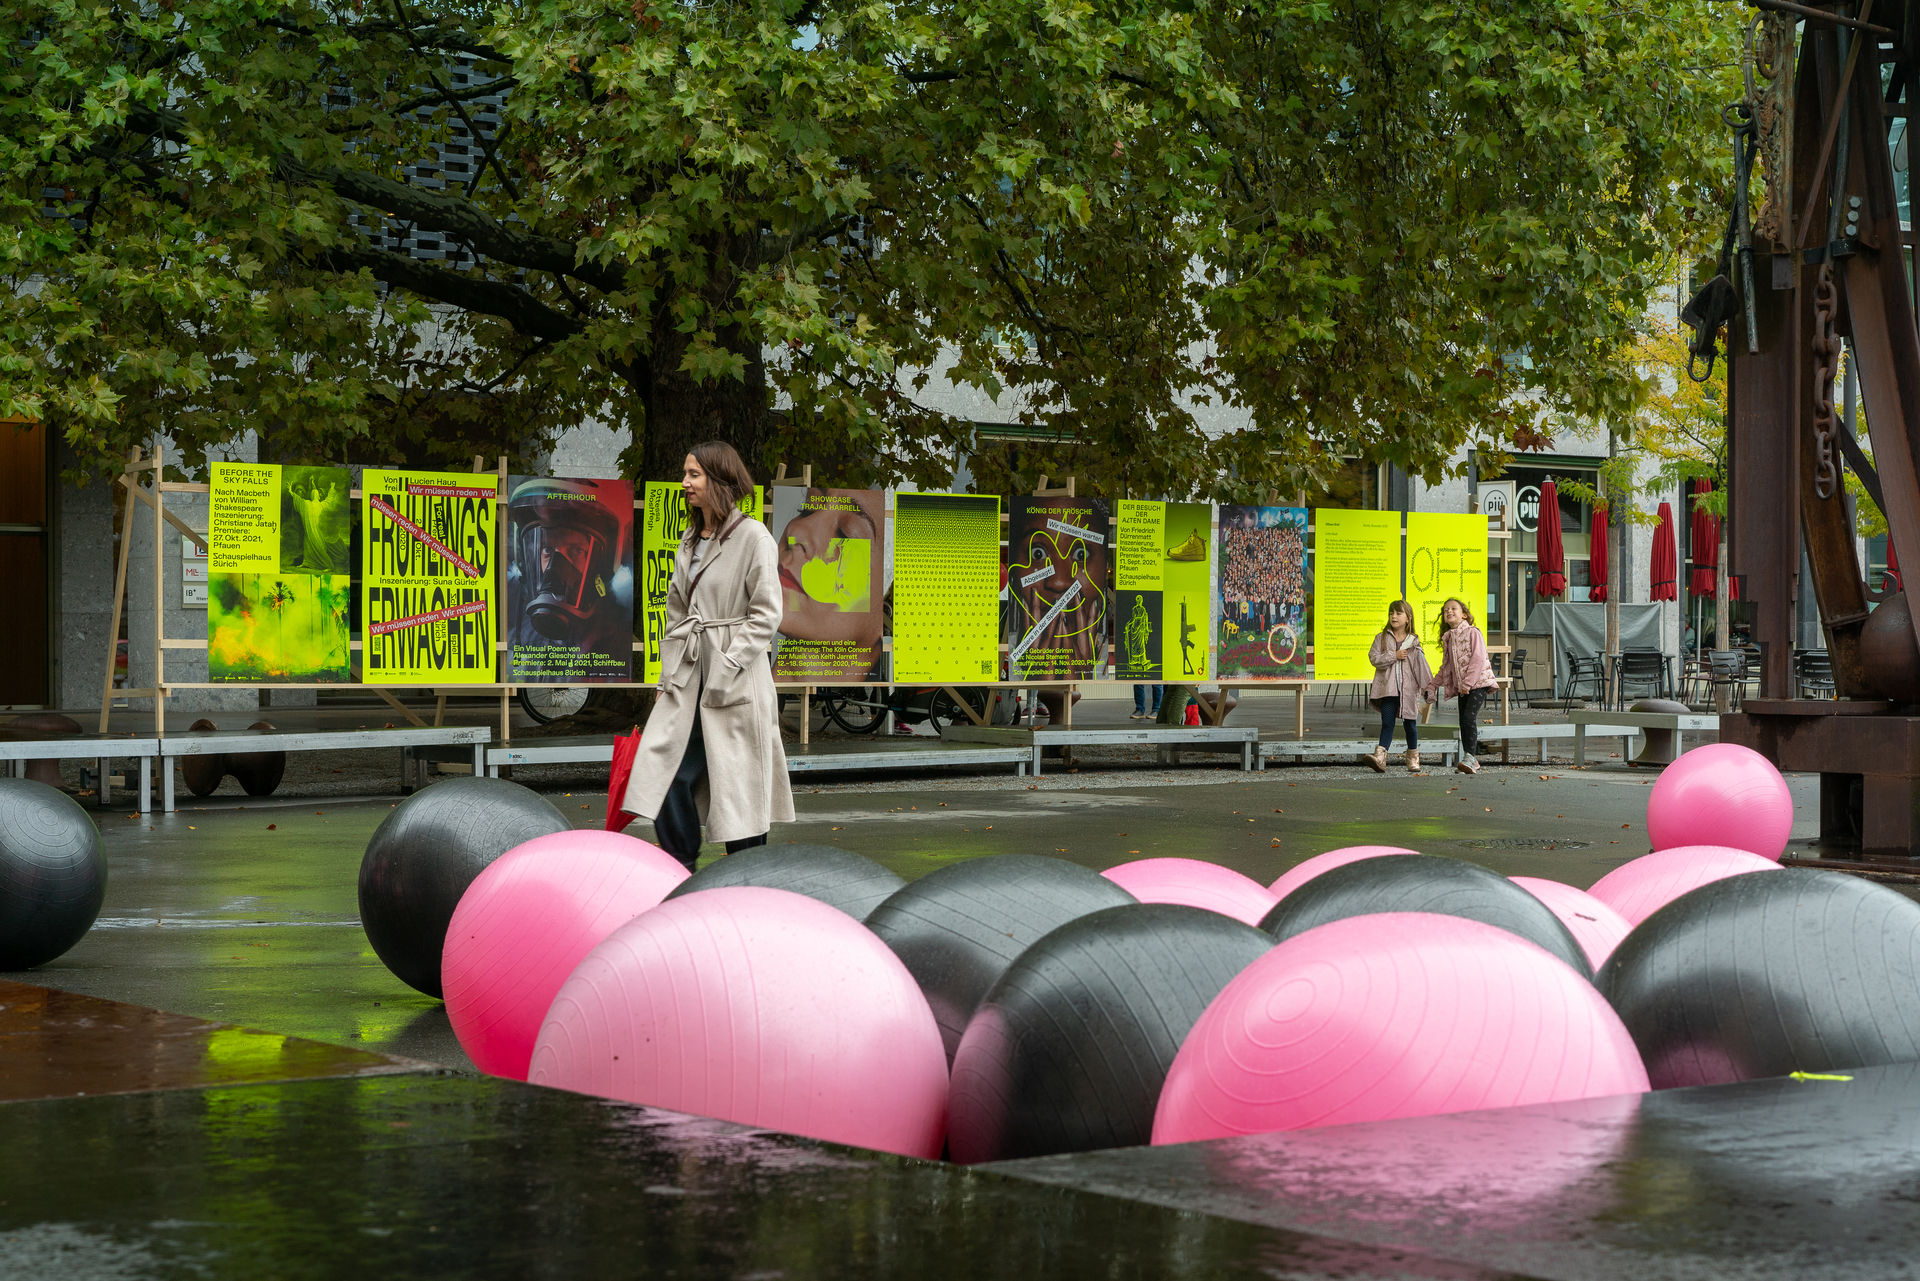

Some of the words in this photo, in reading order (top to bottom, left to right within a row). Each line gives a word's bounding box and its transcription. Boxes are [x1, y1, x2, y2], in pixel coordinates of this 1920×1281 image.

[410, 486, 423, 494] Wir
[425, 487, 454, 495] müssen
[456, 488, 478, 496] reden
[547, 493, 596, 501] AFTERHOUR
[648, 489, 656, 531] Moshfegh
[370, 498, 398, 520] müssen
[398, 515, 417, 534] reden
[420, 531, 432, 544] Wir
[432, 539, 457, 563] müssen
[458, 559, 477, 578] reden
[1060, 525, 1081, 535] müssen
[1082, 532, 1102, 542] warten
[380, 578, 430, 586] Inszenierung:
[369, 587, 489, 670] ERWACHEN
[387, 620, 416, 631] müssen
[417, 613, 439, 623] reden
[456, 603, 485, 614] müssen
[1013, 636, 1034, 659] Premiere
[1046, 598, 1066, 620] Spielzeit
